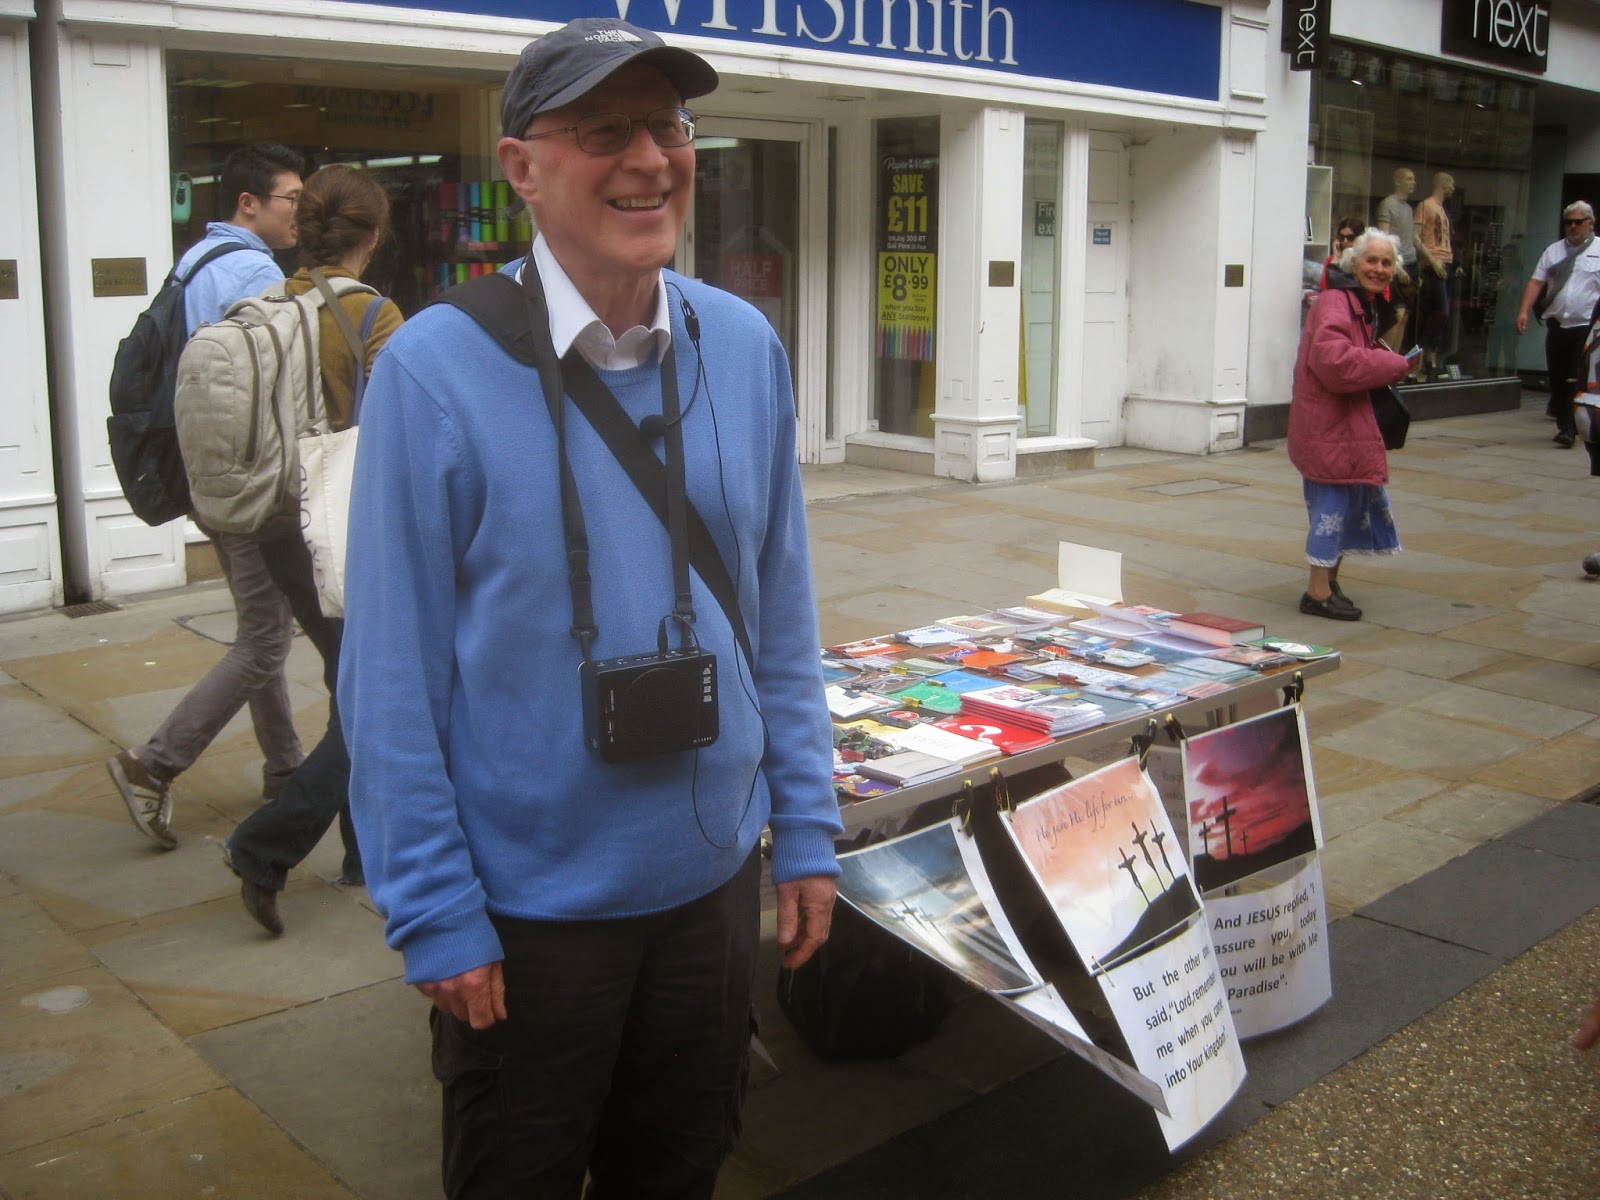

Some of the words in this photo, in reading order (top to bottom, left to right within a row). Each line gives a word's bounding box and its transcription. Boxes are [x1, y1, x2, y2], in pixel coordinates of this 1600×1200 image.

[1297, 0, 1317, 64] next
[1473, 0, 1548, 57] next
[892, 174, 924, 193] SAVE
[887, 195, 928, 233] £11
[731, 260, 773, 278] HALF
[884, 255, 929, 274] ONLY
[881, 311, 897, 320] ANY
[914, 305, 927, 313] buy
[1085, 794, 1101, 833] life
[1213, 914, 1242, 931] And
[1246, 905, 1281, 926] JESUS
[1283, 888, 1309, 914] replied,
[1214, 938, 1256, 955] assure
[1270, 928, 1293, 947] you,
[1299, 908, 1317, 929] today
[1243, 956, 1266, 974] will
[1271, 953, 1285, 967] be
[1288, 941, 1307, 960] with
[1308, 931, 1319, 948] Me
[1132, 979, 1156, 1002] But
[1161, 969, 1180, 988] the
[1183, 953, 1202, 975] other
[1155, 1040, 1175, 1060] me
[1177, 1023, 1200, 1047] when
[1200, 1011, 1213, 1032] you
[1164, 1066, 1188, 1089] into
[1186, 1053, 1205, 1075] Your
